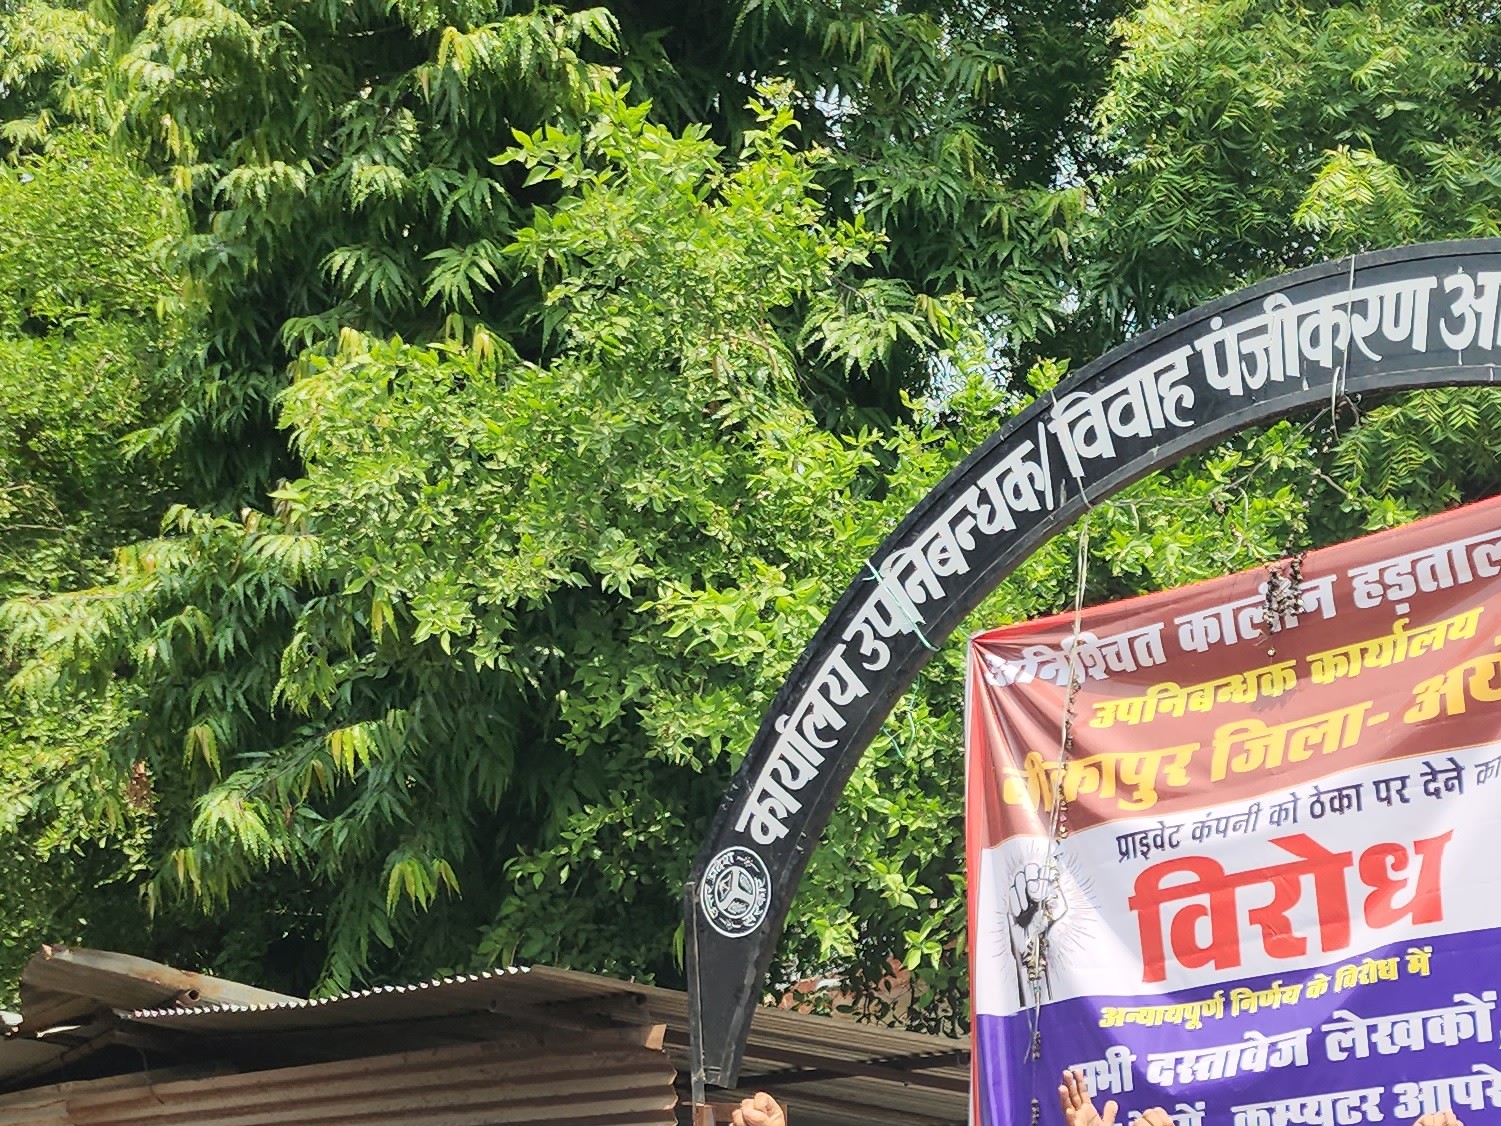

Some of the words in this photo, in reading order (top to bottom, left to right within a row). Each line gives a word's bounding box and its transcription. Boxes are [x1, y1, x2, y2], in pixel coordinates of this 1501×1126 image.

[735, 643, 869, 844] कार्यालय
[1194, 276, 1437, 395] पंजीकरण
[1089, 659, 1297, 728] उपनिबन्धक
[1307, 606, 1484, 684] कार्यालय
[1116, 820, 1183, 862] प्राइवेट
[1191, 806, 1262, 843] कंपनी
[1269, 792, 1300, 826] को
[1309, 785, 1364, 819] ठेका
[1372, 774, 1411, 807] पर
[1419, 757, 1465, 799] देने
[1128, 829, 1454, 983] विरोध
[1099, 989, 1225, 1030] अन्यायपूर्ण
[1230, 981, 1303, 1017] निर्णय
[1306, 974, 1332, 999] के
[1335, 955, 1401, 993] विरोध
[1405, 946, 1433, 977] में
[1146, 1030, 1312, 1087] दस्तावेज
